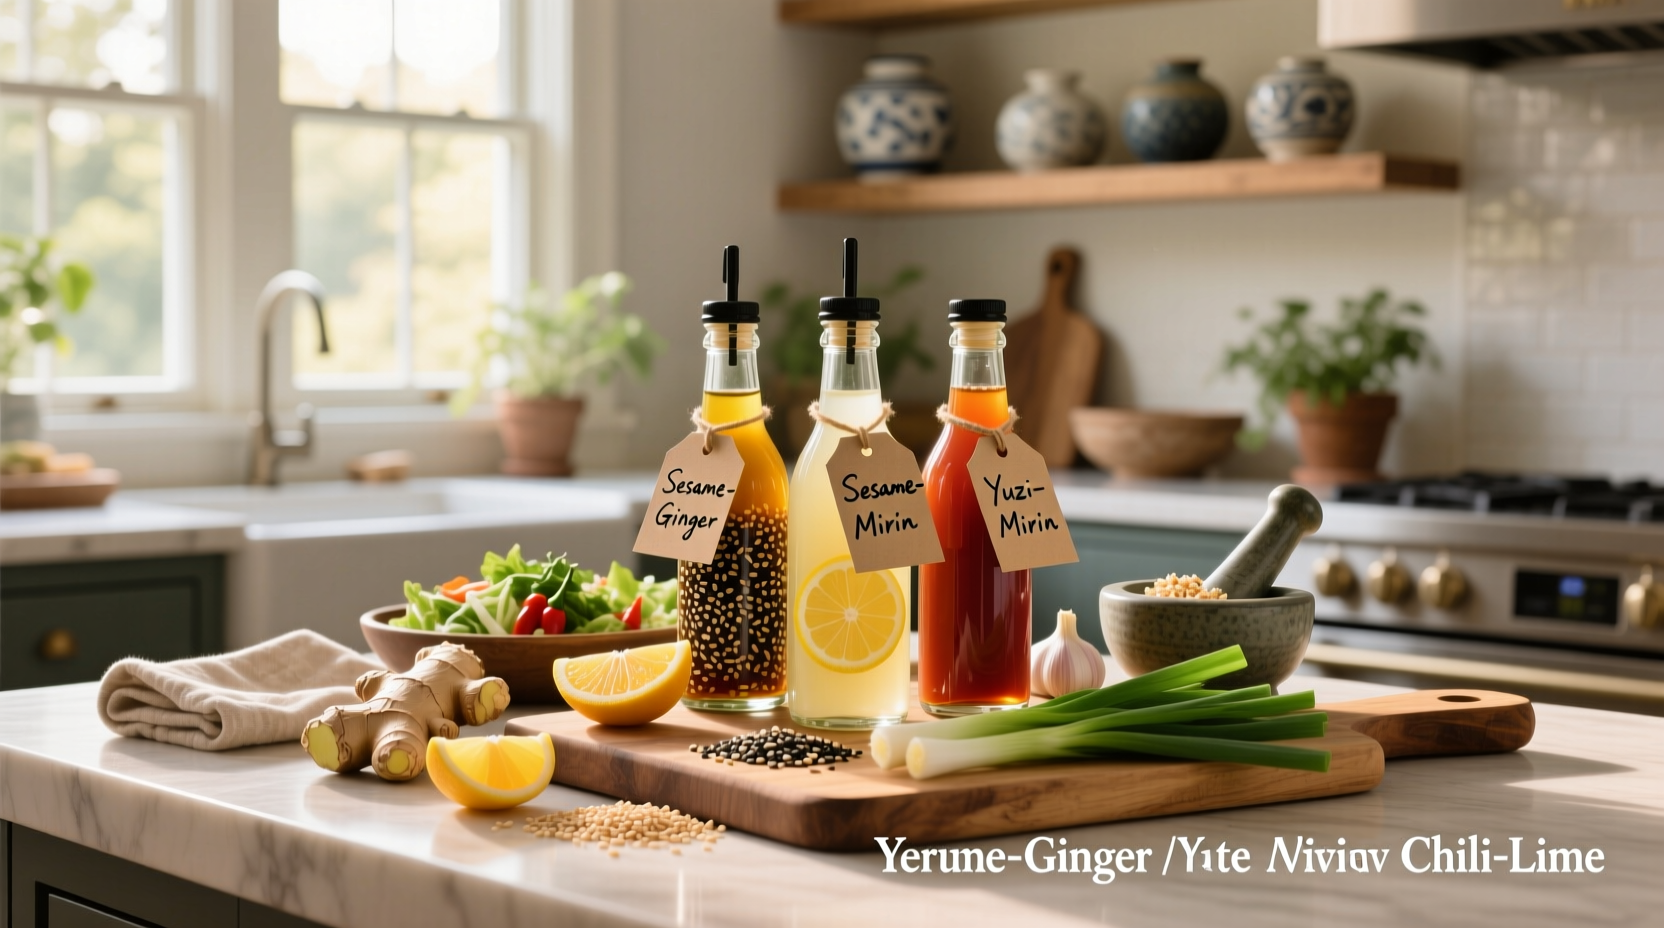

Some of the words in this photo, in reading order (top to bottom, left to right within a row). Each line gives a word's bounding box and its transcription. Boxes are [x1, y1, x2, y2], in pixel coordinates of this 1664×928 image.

[662, 468, 735, 498] Sesame-
[842, 473, 925, 503] Sesame-
[983, 473, 1045, 507] Yuzi-
[655, 501, 718, 541] Ginger
[855, 510, 919, 541] Mirin
[1000, 510, 1059, 540] Mirin
